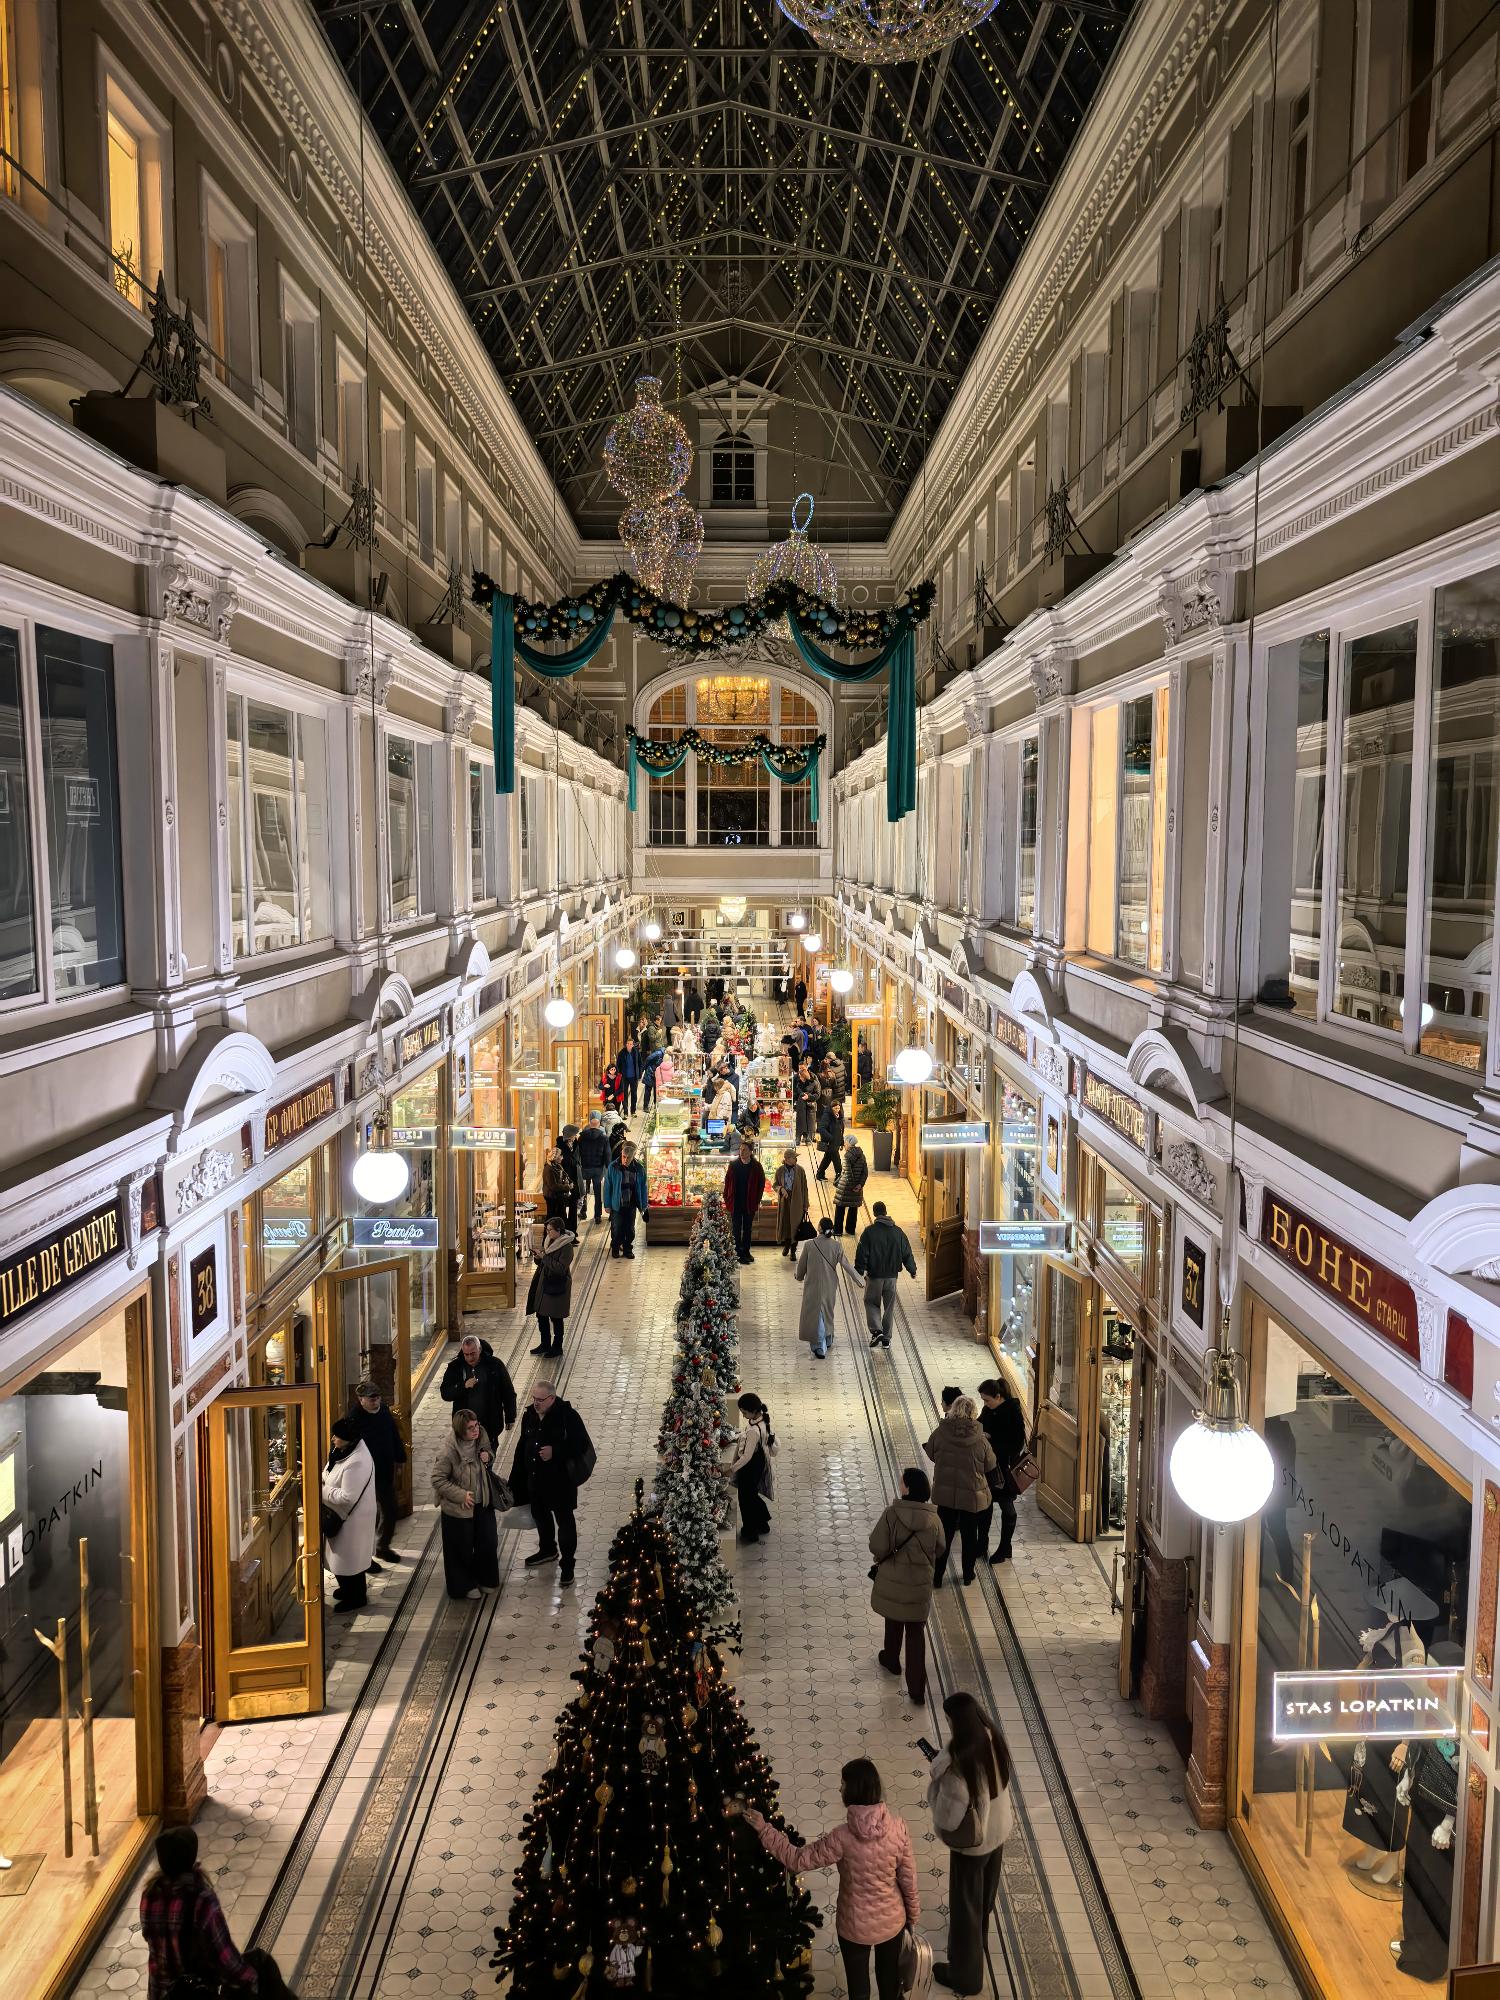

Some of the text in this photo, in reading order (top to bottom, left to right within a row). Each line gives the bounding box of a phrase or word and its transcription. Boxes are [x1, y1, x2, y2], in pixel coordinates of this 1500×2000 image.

[0, 1256, 39, 1317] ILLE
[40, 1243, 61, 1293] DE
[197, 1265, 214, 1315] 38
[1185, 1255, 1200, 1309] 37
[1270, 1203, 1408, 1341] БОНЕ СТАРШ.
[12, 1459, 102, 1569] LOPATKIN
[1282, 1467, 1412, 1635] STAS LOPATKIN
[1286, 1697, 1440, 1716] STAS LOPATKIN
